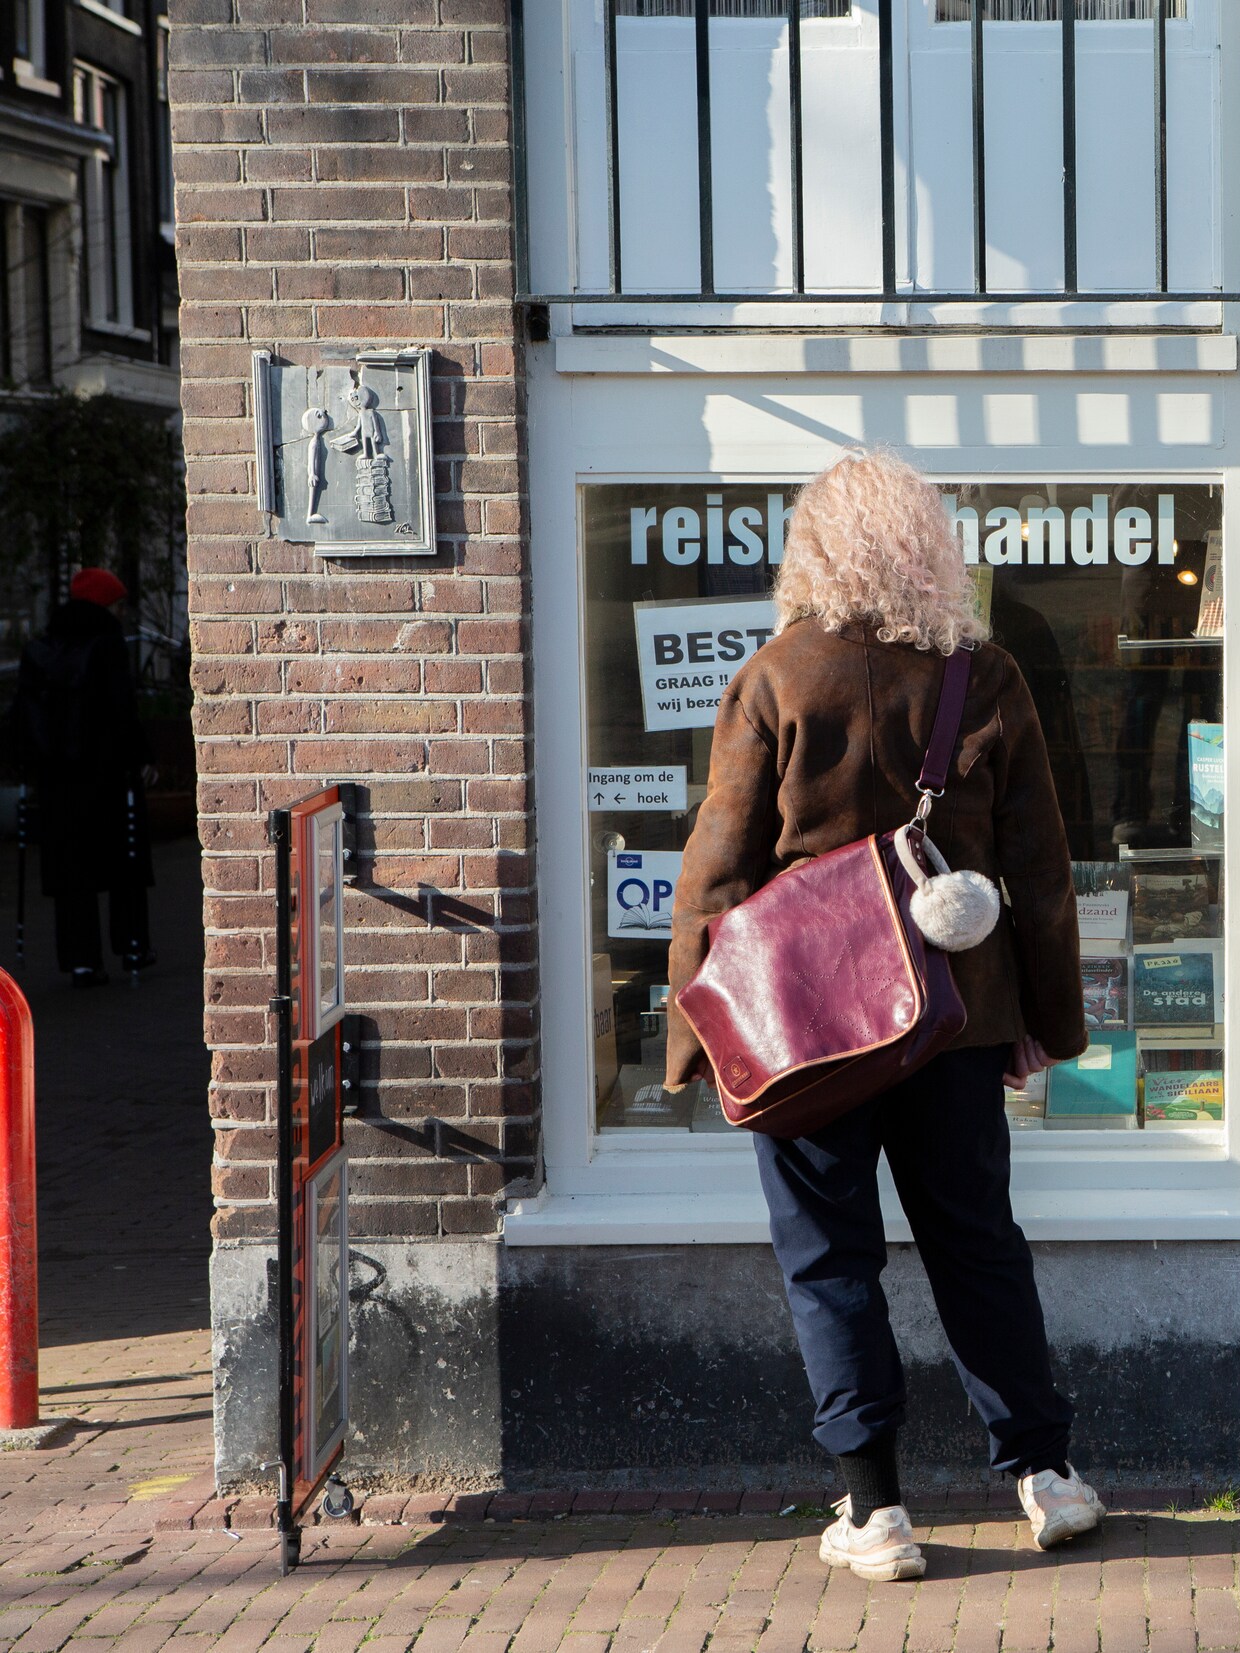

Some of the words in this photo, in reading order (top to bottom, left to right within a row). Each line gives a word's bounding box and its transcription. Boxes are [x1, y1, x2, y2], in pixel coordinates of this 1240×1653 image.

[630, 493, 1175, 566] reishandel
[655, 675, 714, 690] GRAAG
[657, 698, 681, 712] wij
[588, 771, 631, 786] Ingang
[634, 773, 654, 783] om
[658, 770, 674, 783] de
[637, 792, 669, 804] hoek
[1153, 993, 1206, 1006] stad
[1149, 1080, 1220, 1093] WANDELAARS
[1167, 1087, 1220, 1097] SICILIAAN
